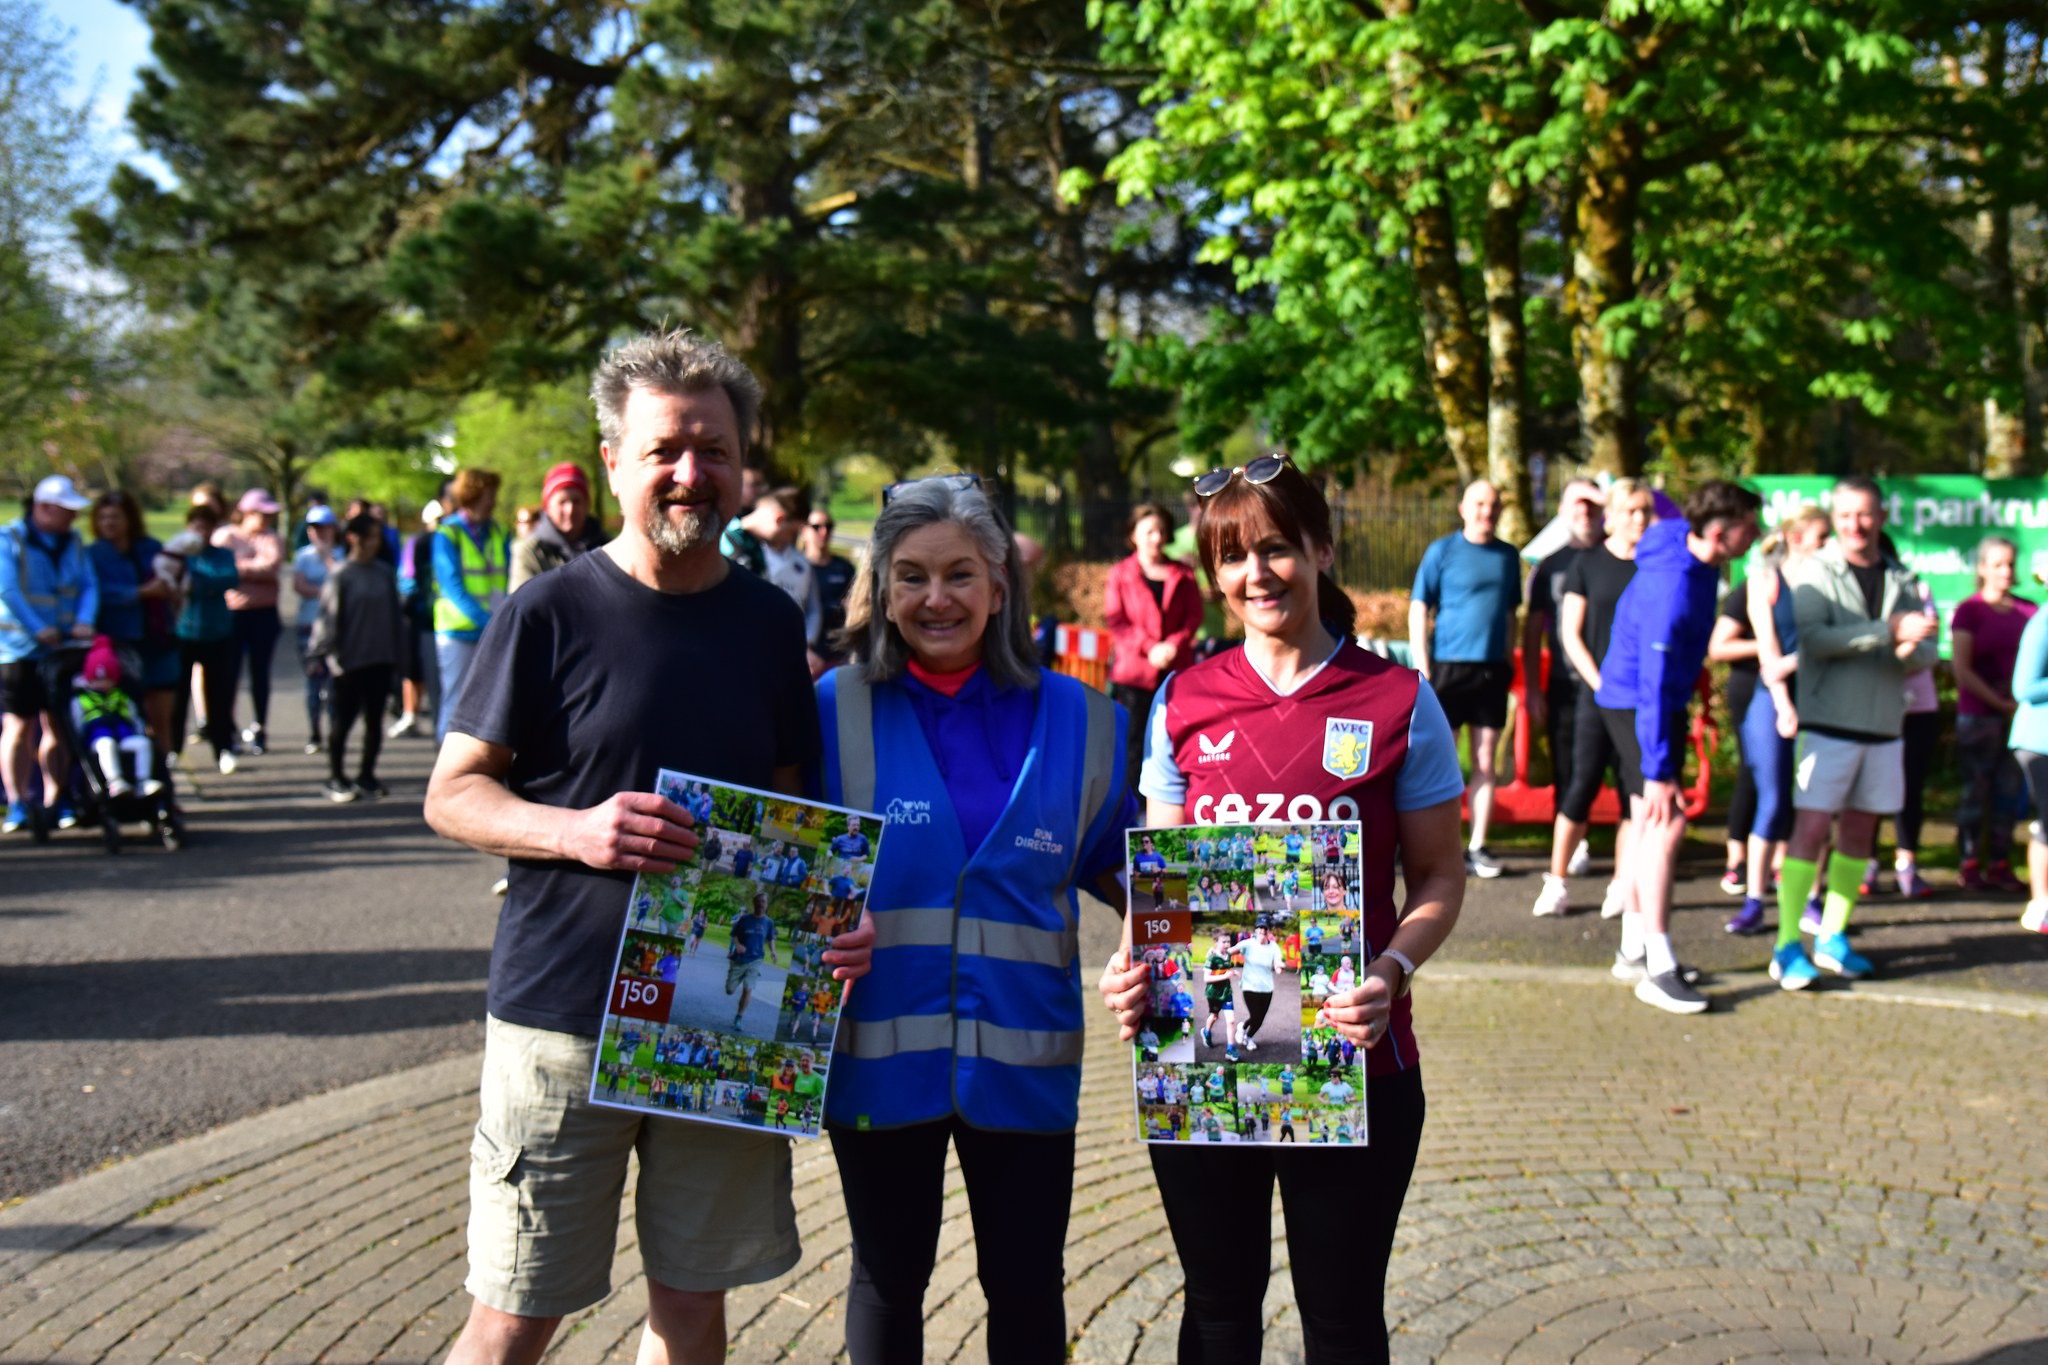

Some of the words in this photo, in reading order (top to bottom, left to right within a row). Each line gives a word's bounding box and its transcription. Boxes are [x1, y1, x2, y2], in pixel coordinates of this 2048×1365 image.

[1331, 722, 1368, 735] AVFC
[886, 806, 930, 824] rkrun
[1194, 793, 1359, 824] CAZOO
[1034, 828, 1052, 841] RUN
[1015, 835, 1063, 854] DIRECTOR
[1144, 919, 1170, 939] 150
[619, 979, 659, 1010] 150
